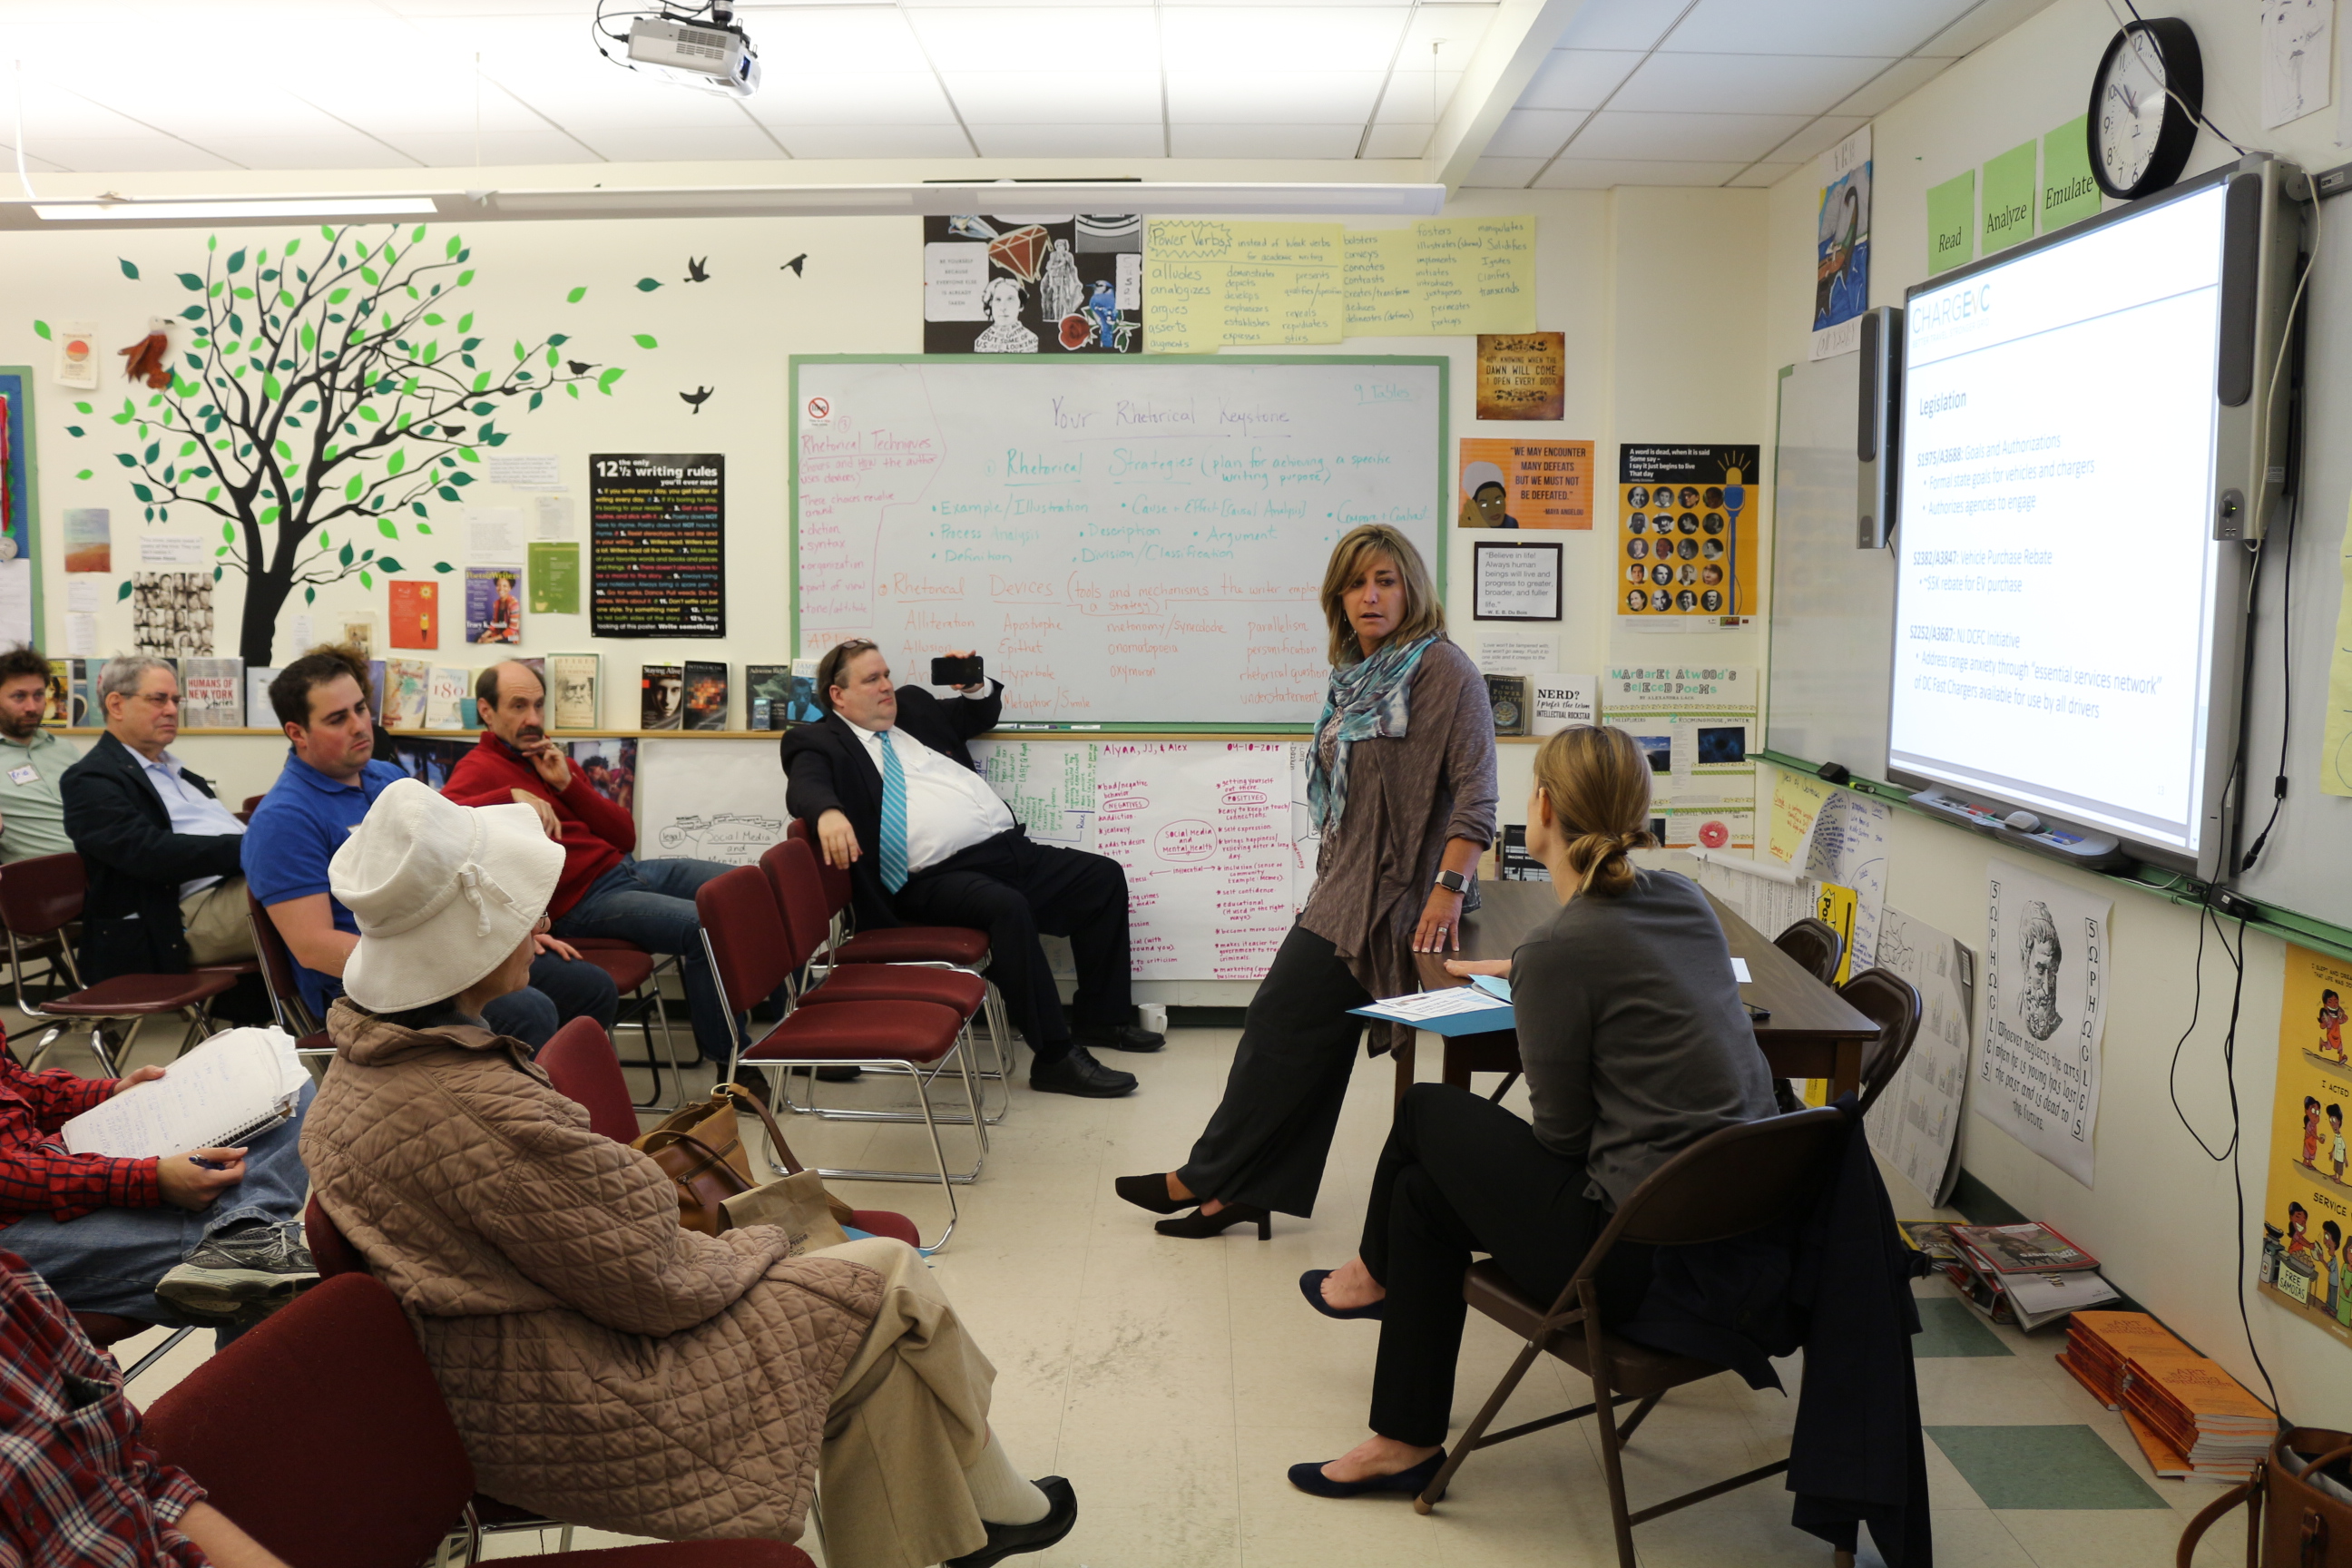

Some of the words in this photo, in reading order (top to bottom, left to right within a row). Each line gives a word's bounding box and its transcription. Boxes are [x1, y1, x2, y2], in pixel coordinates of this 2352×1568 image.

[2104, 117, 2110, 134] 9
[2107, 147, 2112, 166] 8
[2118, 167, 2123, 183] 7
[2046, 176, 2093, 210] Emulate
[1986, 204, 2026, 233] Analyze
[1152, 228, 1186, 247] Power
[1191, 226, 1225, 246] Verbs
[1938, 227, 1961, 252] Read
[1152, 263, 1201, 280] alludes
[1151, 306, 1188, 322] argues
[1486, 366, 1506, 375] DAWN
[1513, 366, 1530, 375] WILL
[1515, 377, 1534, 386] EVERY
[1540, 377, 1556, 386] DOOR
[1919, 390, 1966, 418] Legislation
[1053, 397, 1093, 428] Your
[1117, 397, 1195, 426] Rhetorical
[1220, 397, 1289, 436] Keystone
[801, 432, 860, 454] Rhetorical
[871, 429, 931, 454] Techniques
[1965, 443, 1984, 460] Goals
[1986, 440, 2000, 456] and
[2003, 434, 2061, 455] Authorizations
[1527, 447, 1542, 456] MAY
[1544, 447, 1586, 457] ENCOUNTER
[635, 466, 683, 478] writing
[687, 466, 718, 476] rules
[1007, 448, 1083, 476] Rhetorical
[1109, 448, 1193, 480] Strategies
[1521, 462, 1542, 470] MANY
[1544, 463, 1573, 471] DEFEATS
[1515, 475, 1529, 485] BUT
[1531, 476, 1542, 485] WE
[1544, 476, 1563, 485] MUST
[1565, 477, 1579, 485] NOT
[1930, 474, 1952, 490] Formal
[1954, 472, 1970, 487] state
[1973, 470, 1991, 489] goals
[1993, 466, 2004, 483] for
[2005, 464, 2036, 481] vehicles
[2039, 461, 2054, 478] and
[2057, 459, 2094, 478] chargers
[1521, 490, 1530, 499] BE
[1206, 525, 1278, 547] Argument
[946, 548, 1012, 563] Definition
[1961, 550, 1985, 564] Vehicle
[1988, 550, 2022, 564] Purchase
[2024, 549, 2053, 564] Rebate
[989, 574, 1053, 597] Devices
[905, 610, 975, 631] Alliteration
[1004, 613, 1063, 637] Apostrophe
[1248, 614, 1308, 640] parallelism
[1957, 628, 1965, 643] NJ
[1988, 630, 2020, 648] Initiative
[1108, 638, 1178, 659] onomatopoeia
[1247, 638, 1317, 663] personification
[643, 666, 665, 675] Staying
[666, 667, 681, 675] Alive
[1001, 663, 1055, 686] Hyperbole
[1111, 666, 1155, 682] oxymoron
[1922, 651, 1947, 667] Address
[1949, 657, 1968, 673] range
[1970, 657, 1996, 677] anxiety
[1998, 659, 2029, 681] through
[2074, 670, 2111, 689] services
[189, 679, 220, 687] HUMANS
[224, 679, 232, 687] OF
[189, 691, 207, 699] NEW
[211, 691, 233, 699] YORK
[1240, 687, 1320, 704] understatement
[1538, 690, 1580, 700] NERD?
[1915, 674, 1922, 689] of
[1923, 676, 1932, 691] DC
[1934, 677, 1945, 693] Fast
[1948, 679, 1977, 700] Chargers
[1980, 685, 2012, 703] available
[2014, 688, 2025, 705] for
[2028, 694, 2041, 709] use
[2044, 692, 2053, 714] by
[2056, 695, 2066, 712] all
[2069, 697, 2100, 719] drivers
[1563, 701, 1573, 709] the
[1536, 710, 1566, 719] INTELLECTUAL
[1568, 711, 1590, 720] ROCKSTAR
[1169, 743, 1187, 751] Alex
[1165, 829, 1188, 838] Social
[2024, 1041, 2049, 1065] neglects
[2052, 1054, 2061, 1073] the
[2064, 1063, 2079, 1083] arts
[2322, 1080, 2326, 1088] I
[2329, 1083, 2349, 1097] ACTED
[2314, 1192, 2347, 1216] SERVICE
[2285, 1270, 2301, 1285] FREE
[2279, 1278, 2305, 1299] SAMOSAS
